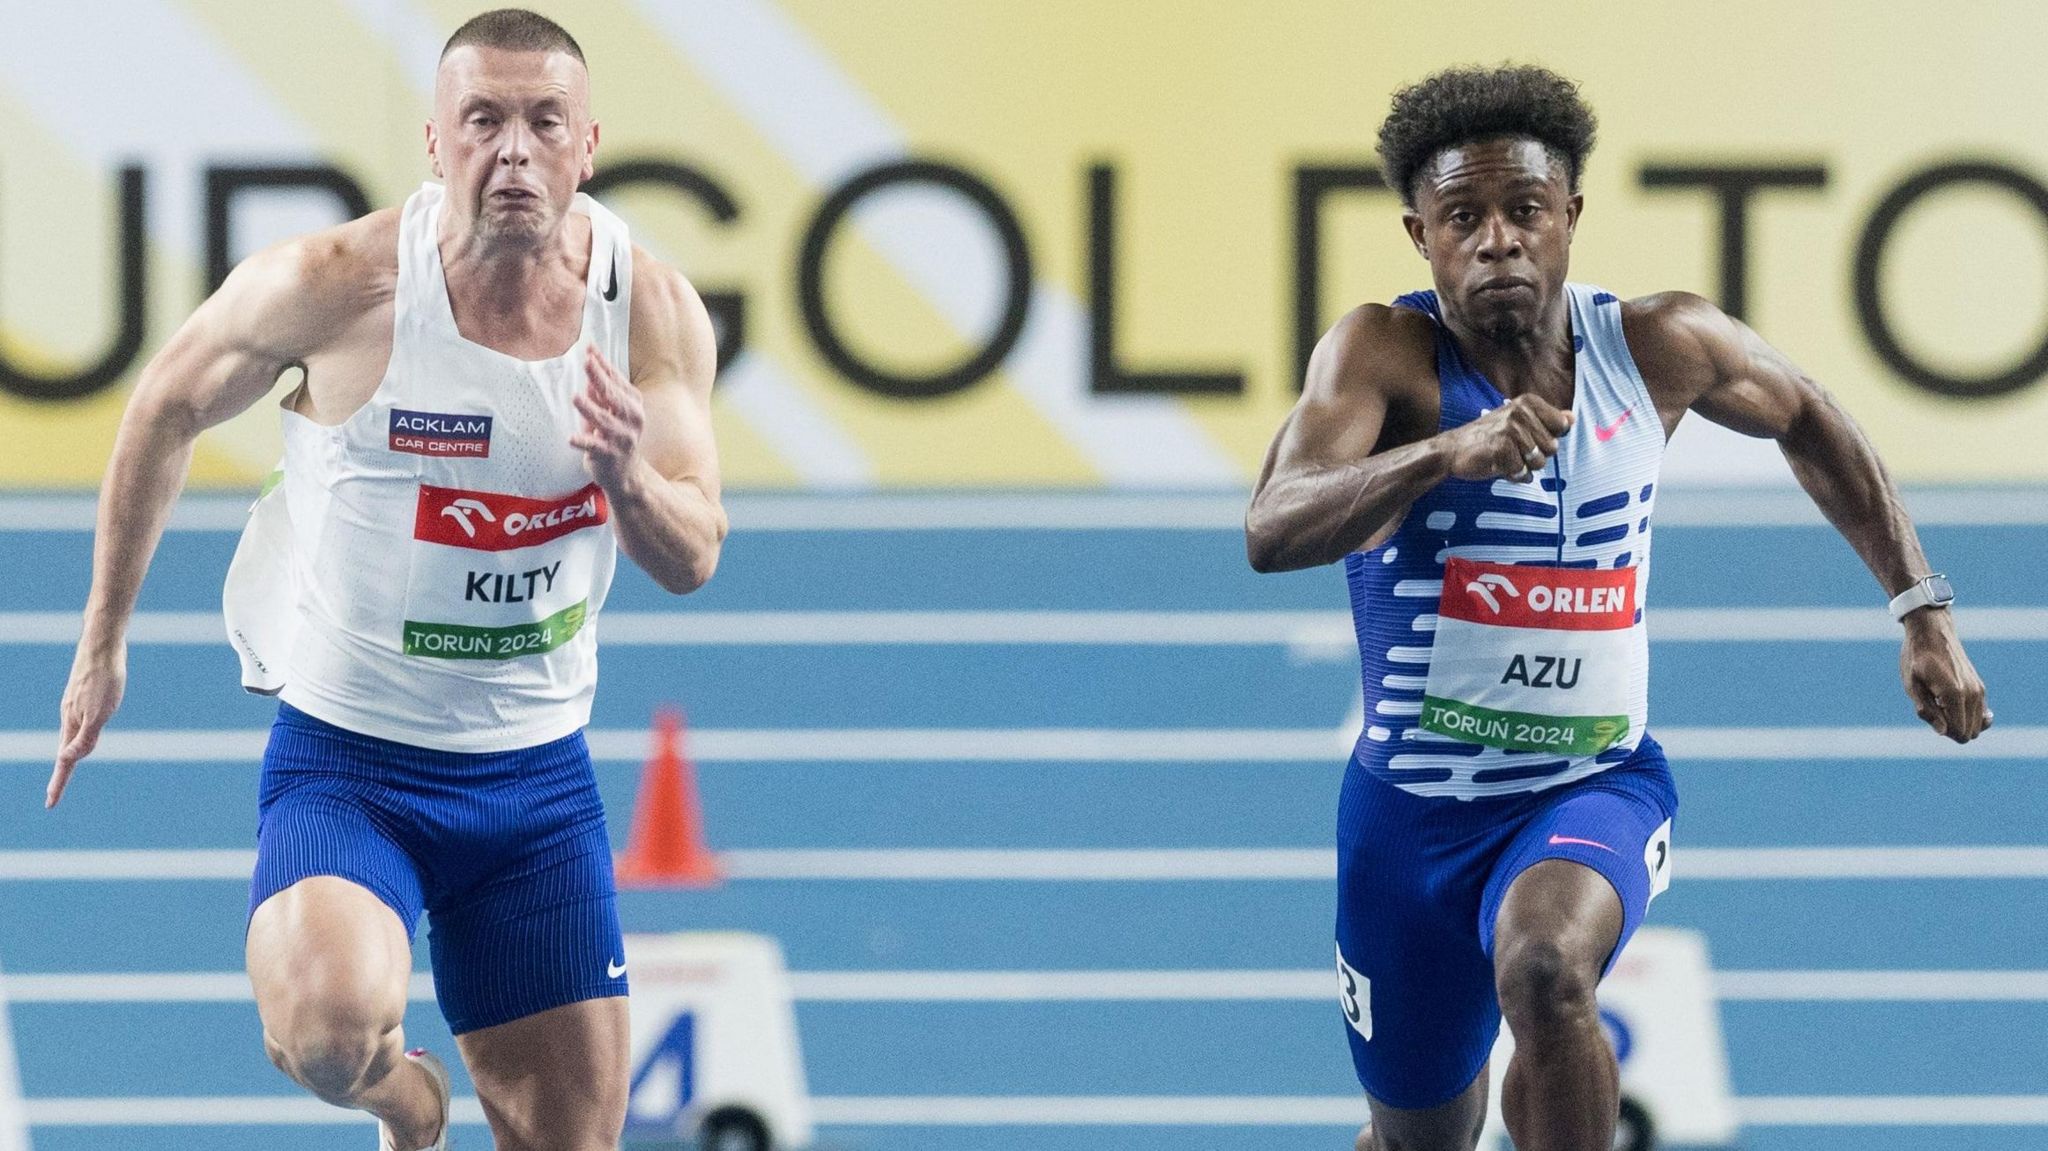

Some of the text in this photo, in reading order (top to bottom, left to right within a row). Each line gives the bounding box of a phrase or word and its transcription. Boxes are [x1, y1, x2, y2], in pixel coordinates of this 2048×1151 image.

[395, 416, 485, 434] ACKLAM
[395, 437, 484, 452] CAR CENTRE
[503, 494, 597, 536] ORLEN
[465, 560, 562, 603] KILTY
[1527, 585, 1626, 613] ORLEN
[410, 628, 552, 653] TORUŃ 2024
[1501, 653, 1582, 690] AZU
[1430, 706, 1575, 745] TORUŃ 2024
[1341, 962, 1361, 1023] 3
